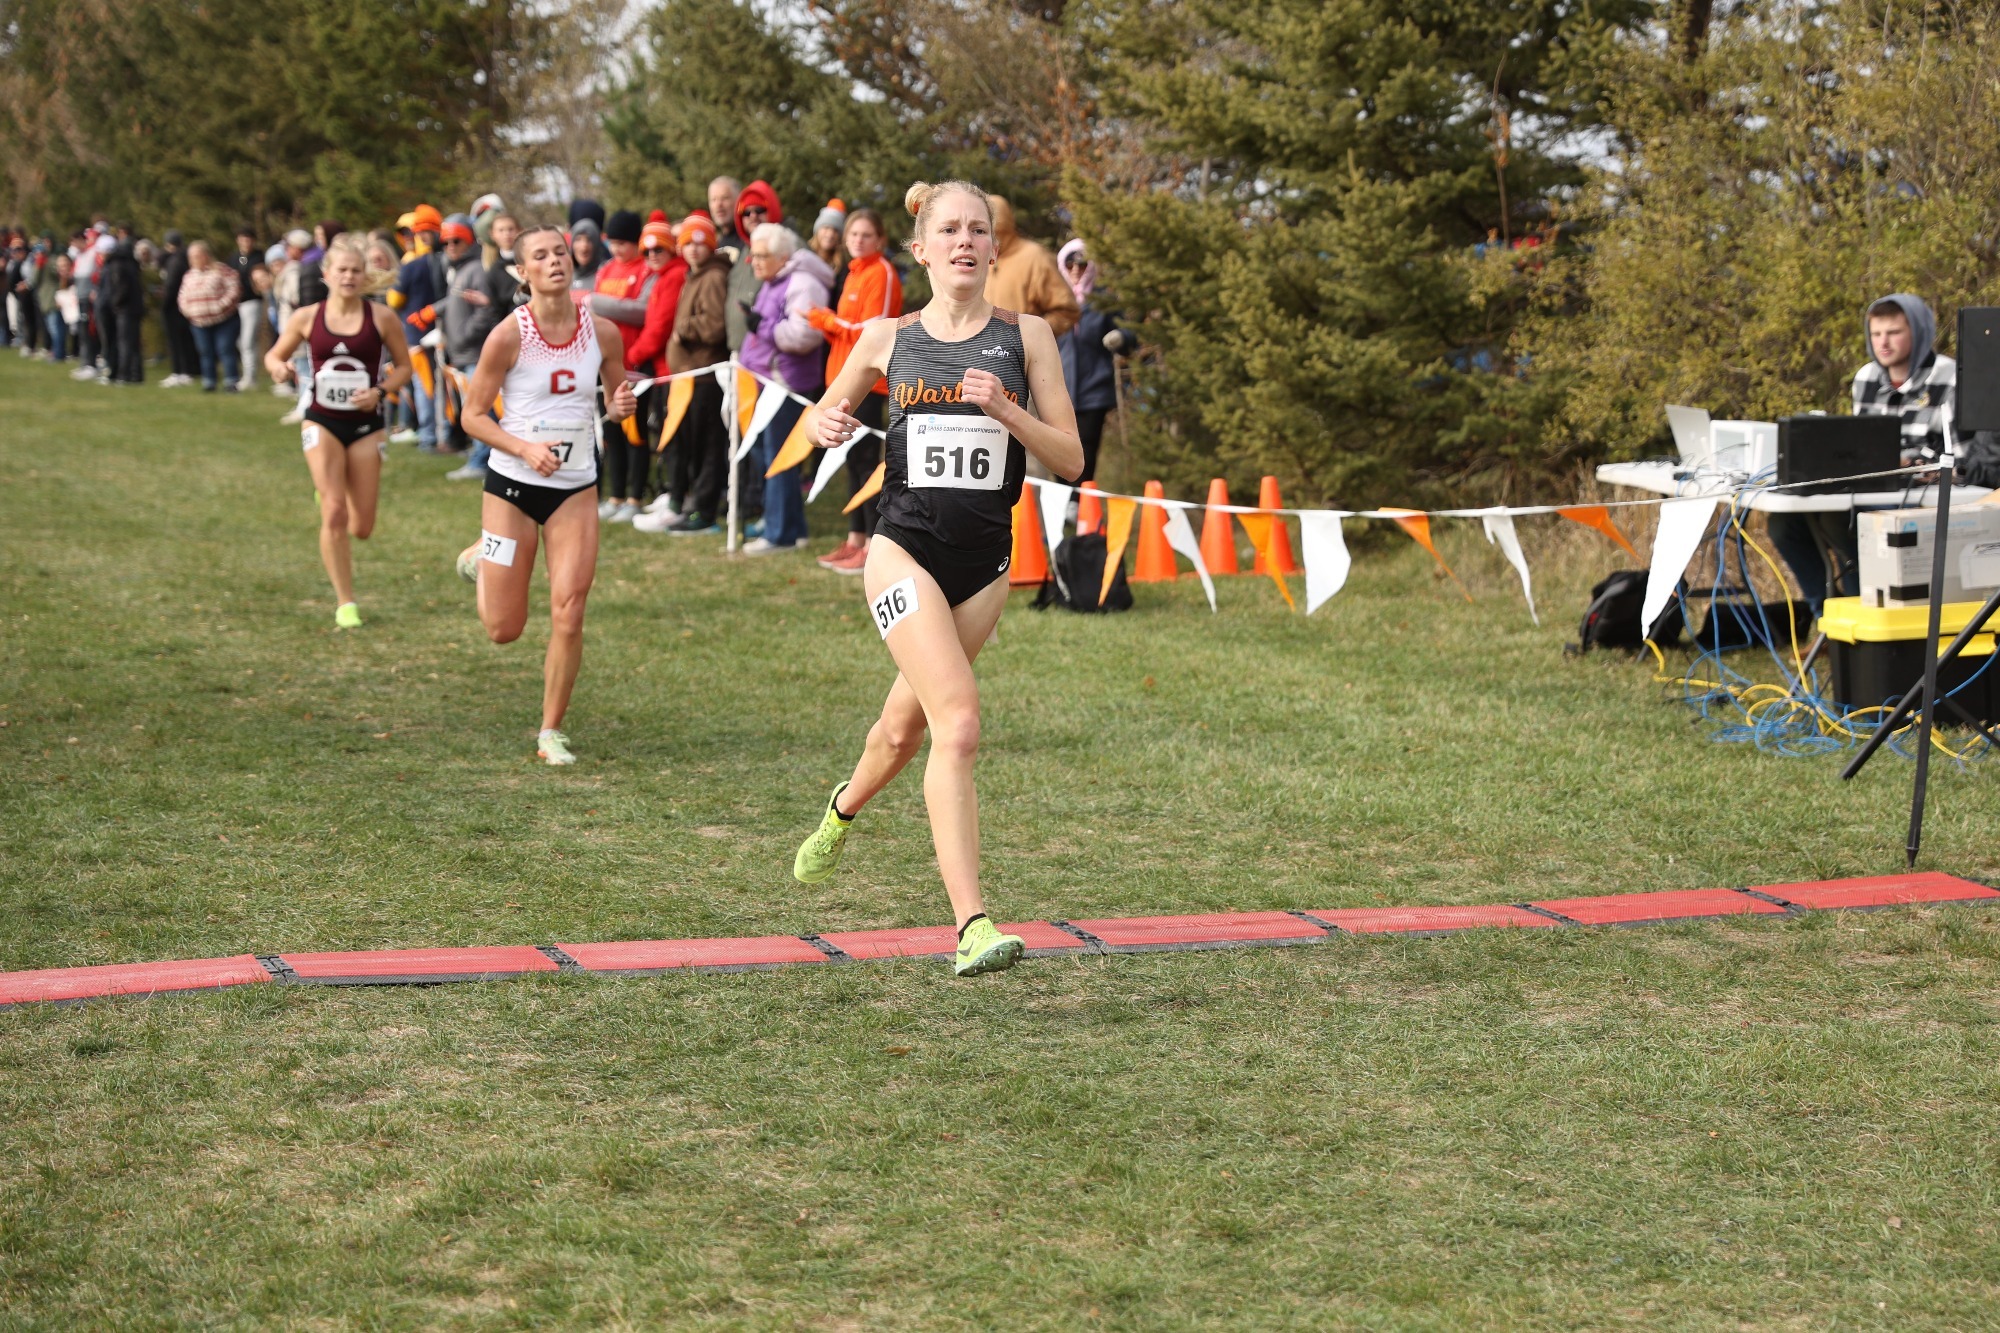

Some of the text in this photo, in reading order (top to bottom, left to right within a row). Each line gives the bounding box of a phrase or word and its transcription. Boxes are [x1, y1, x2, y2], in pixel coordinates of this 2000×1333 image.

[550, 369, 576, 395] C
[894, 378, 1018, 409] Wart
[924, 446, 990, 480] 516
[876, 587, 907, 630] 516
